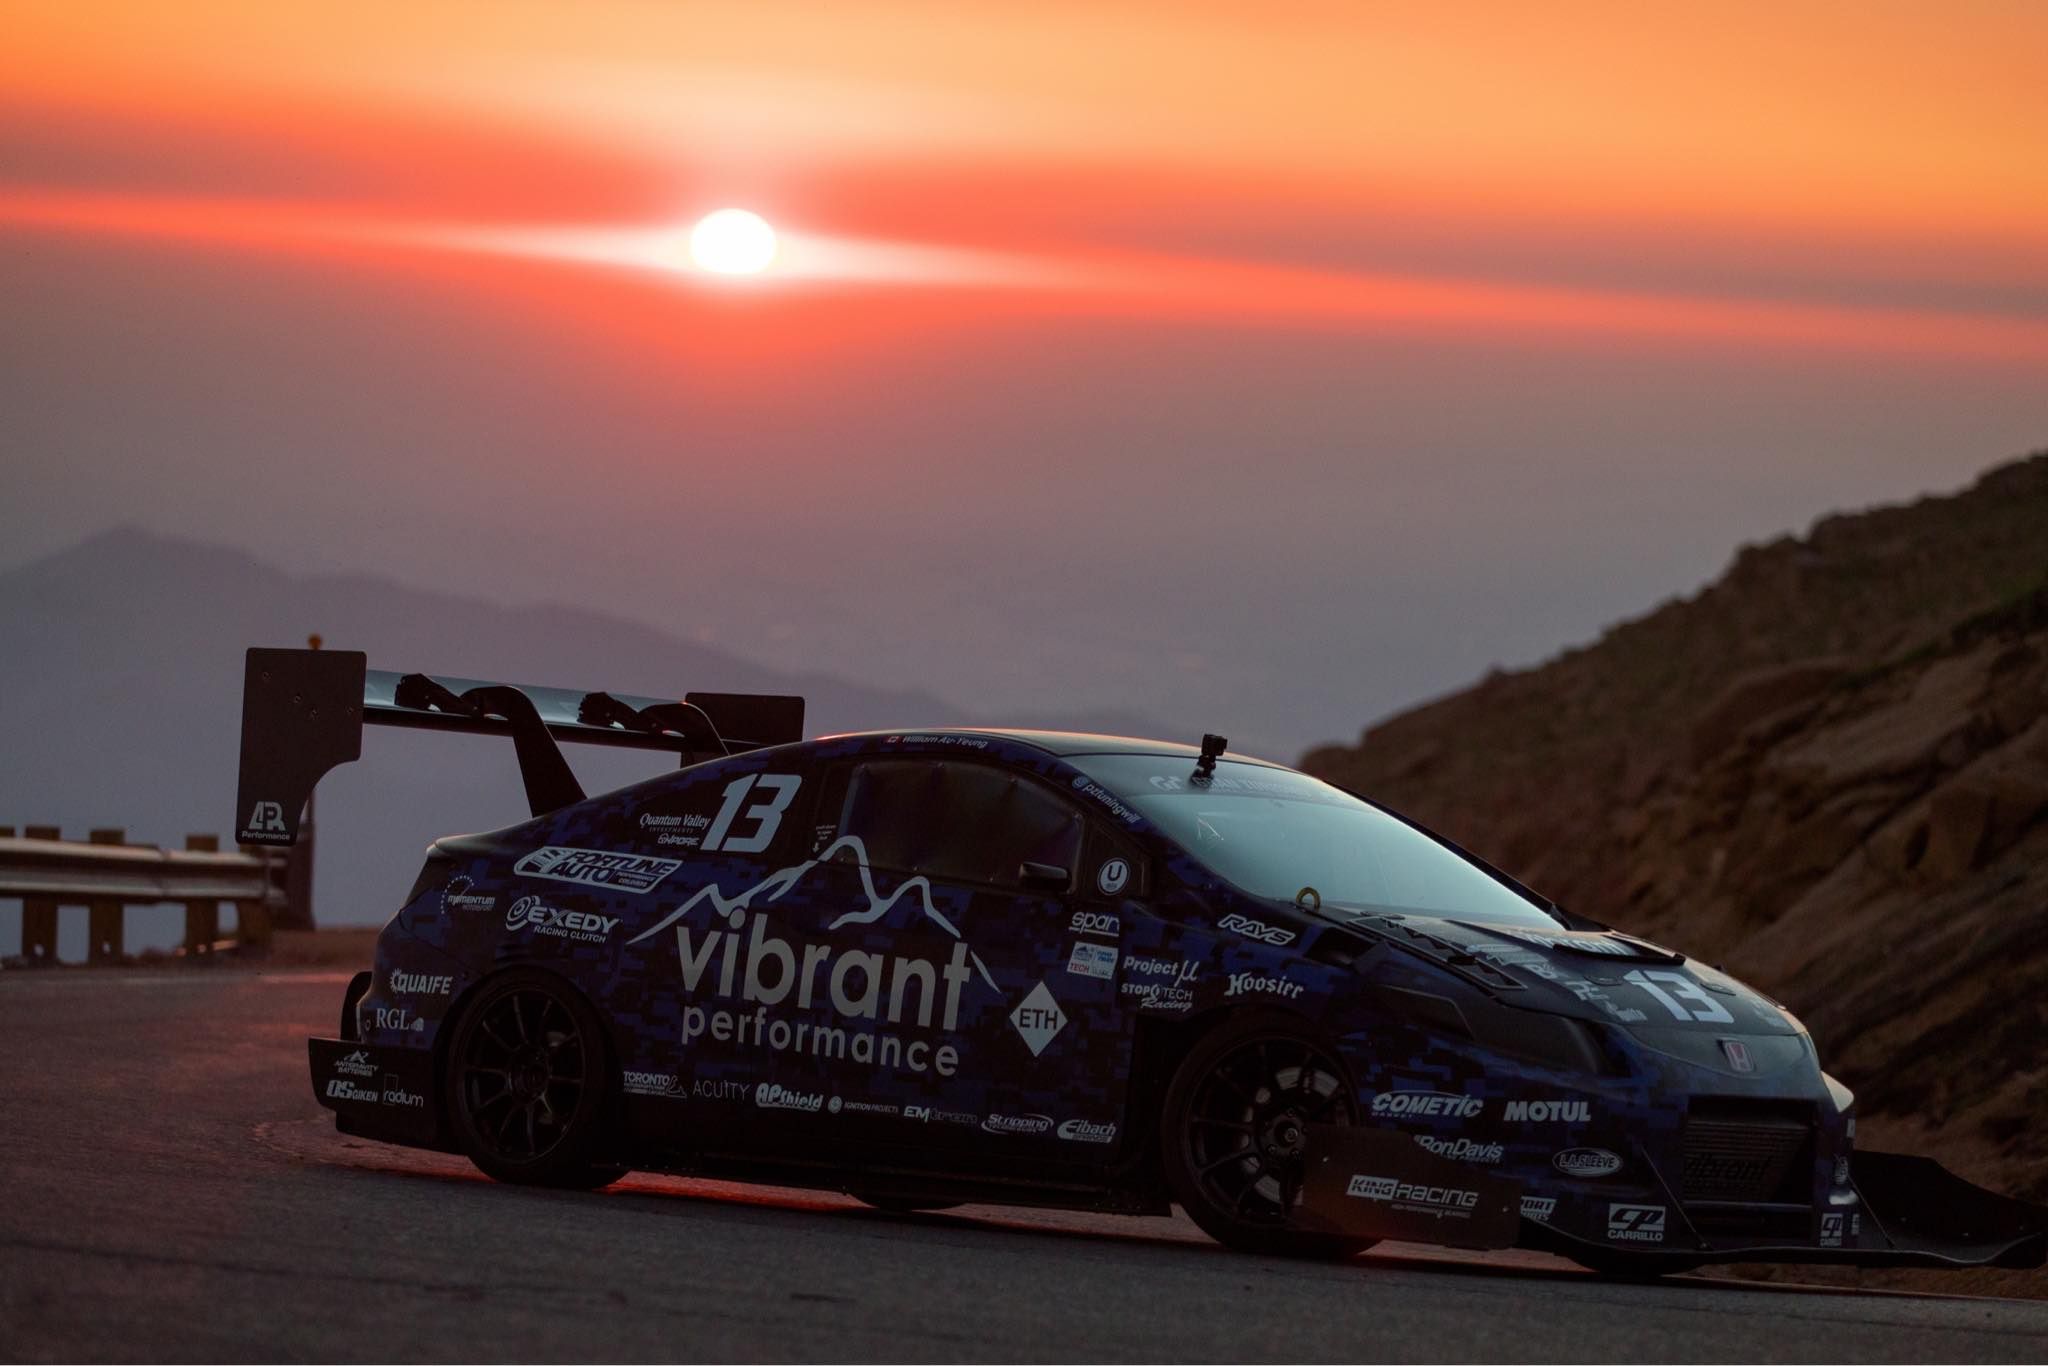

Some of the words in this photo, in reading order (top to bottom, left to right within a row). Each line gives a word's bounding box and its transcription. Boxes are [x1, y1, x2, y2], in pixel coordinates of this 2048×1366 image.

[640, 812, 682, 829] Quantum
[683, 813, 711, 831] Valley
[700, 773, 802, 854] 13
[242, 831, 291, 845] Performance
[550, 861, 615, 884] AUTO
[568, 852, 677, 876] FORTUNE
[527, 905, 621, 934] EXEDY
[1217, 912, 1296, 946] RAYS
[533, 926, 568, 938] RACING
[569, 930, 608, 944] CLUTCH
[676, 908, 971, 1032] vibrant
[1123, 955, 1180, 976] Project
[391, 969, 454, 995] QUAIFE
[1224, 971, 1304, 999] Hoosier
[1140, 997, 1193, 1012] Racing
[1623, 968, 1735, 1023] 13
[1018, 1008, 1059, 1030] ETH
[680, 1005, 960, 1077] performance
[623, 1071, 670, 1087] TORONTO
[692, 1079, 752, 1101] ACUITY
[352, 1089, 378, 1102] GIKEN
[1503, 1100, 1592, 1122] MOTUL
[987, 1113, 1050, 1132] Stripping
[1350, 1177, 1394, 1198] KING
[1608, 1229, 1663, 1241] CARRILLO
